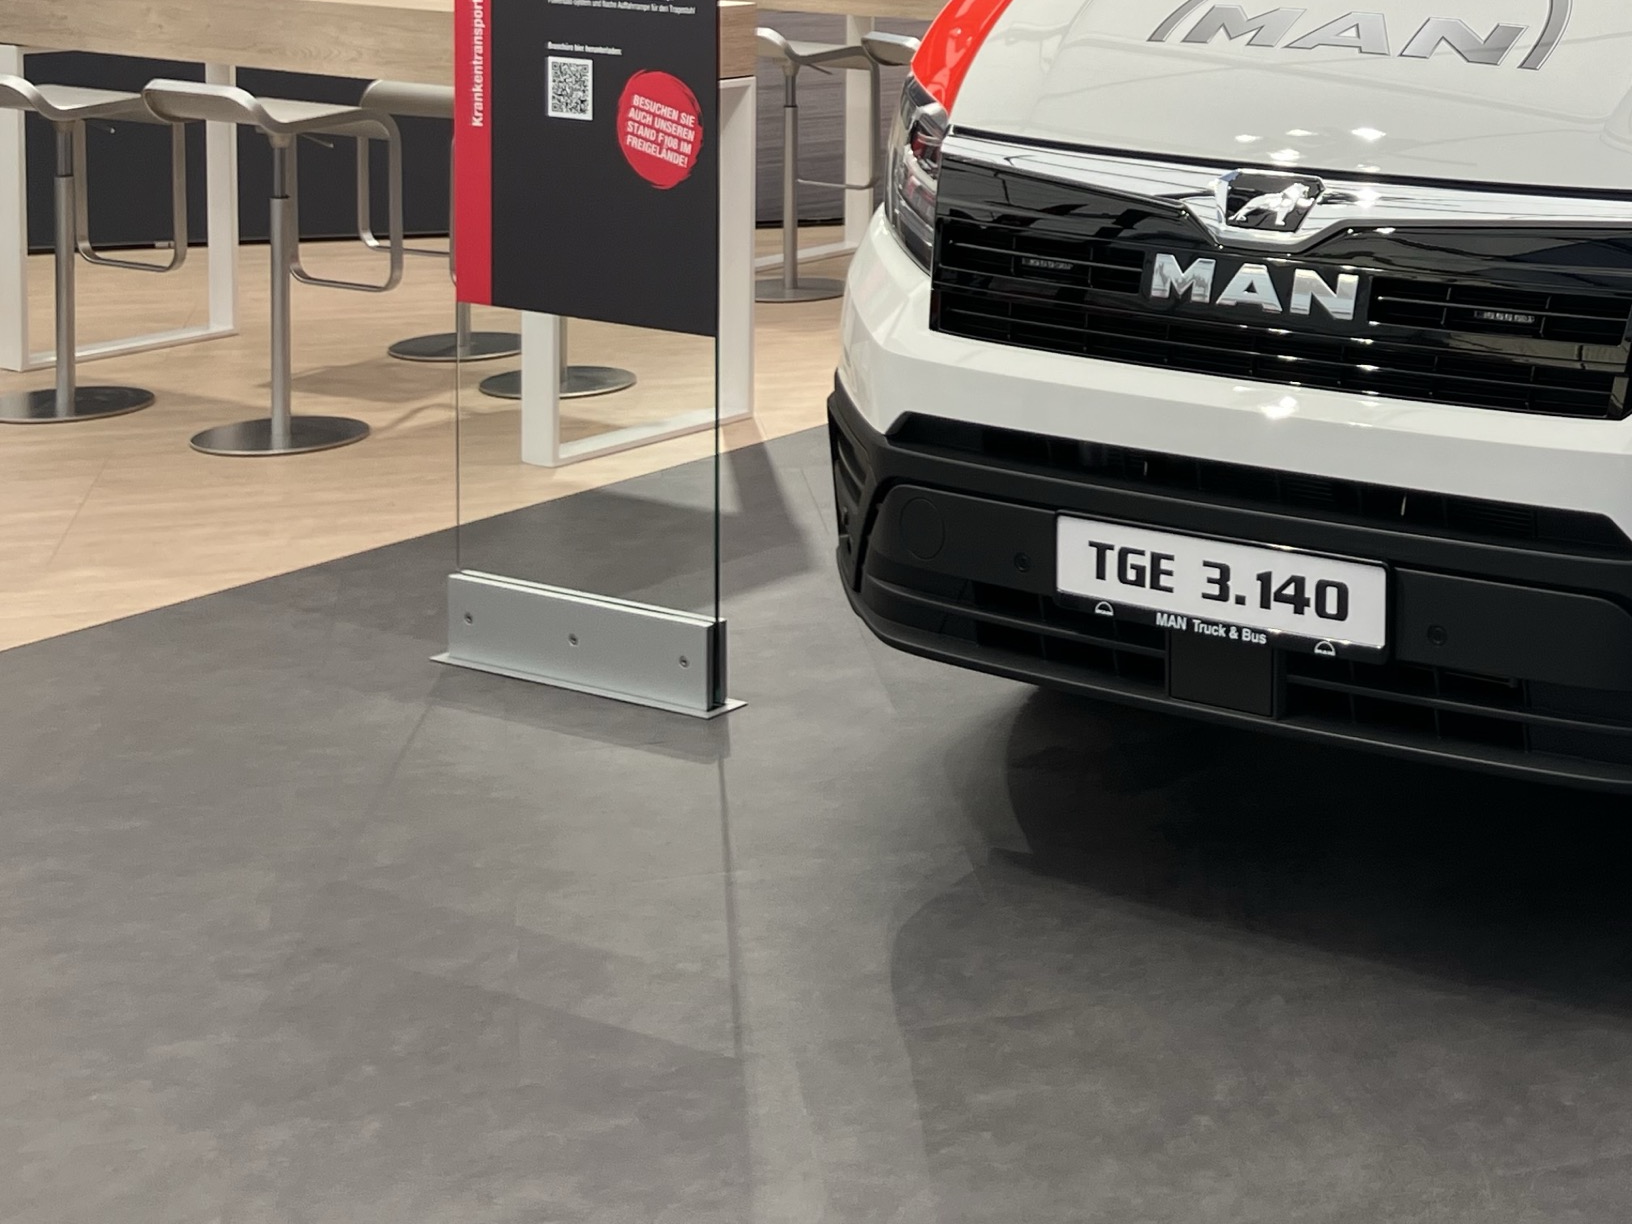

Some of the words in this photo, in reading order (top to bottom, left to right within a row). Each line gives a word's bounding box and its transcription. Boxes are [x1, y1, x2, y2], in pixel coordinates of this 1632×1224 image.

[1180, 4, 1530, 67] MAN
[628, 108, 653, 124] AUCH
[655, 117, 695, 141] UNSEREN
[633, 94, 679, 120] BESUCHEN
[680, 112, 695, 127] SIE
[627, 121, 656, 140] STAND
[1150, 252, 1359, 320] MAN
[1088, 540, 1175, 594] TGE
[1201, 560, 1349, 622] 3.140
[1156, 612, 1187, 630] MAN
[1193, 619, 1226, 638] Truck
[1229, 626, 1239, 640] &
[1242, 627, 1267, 644] Bus
